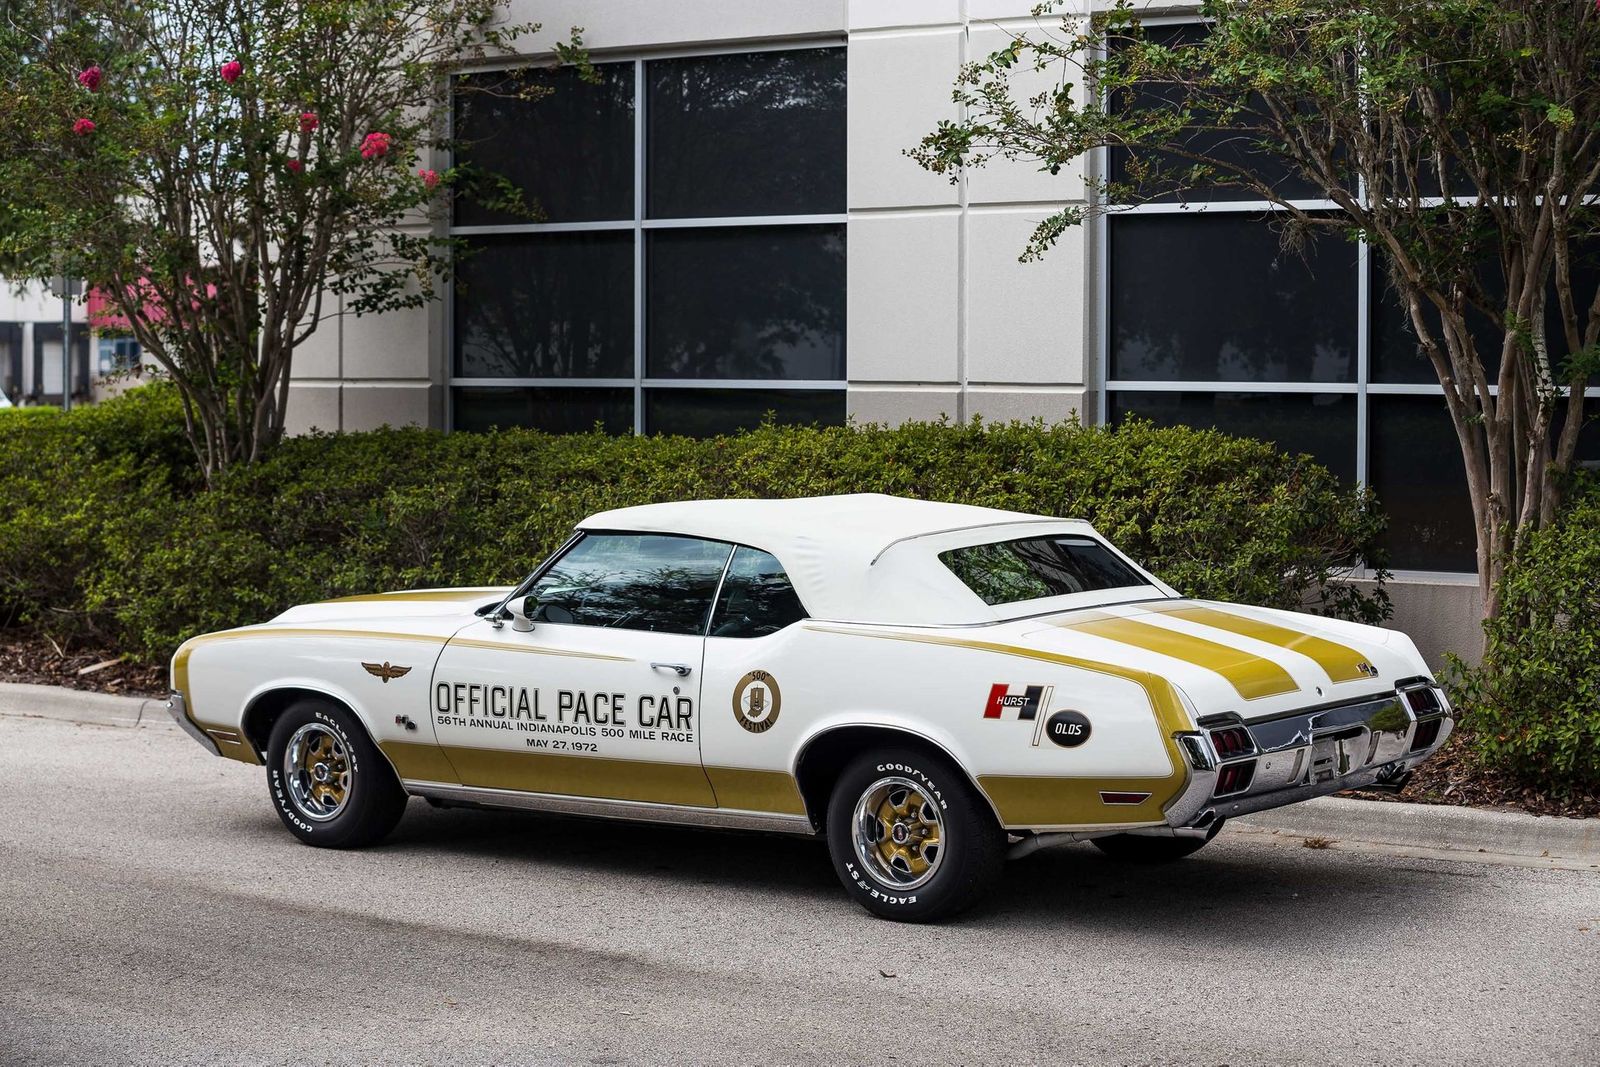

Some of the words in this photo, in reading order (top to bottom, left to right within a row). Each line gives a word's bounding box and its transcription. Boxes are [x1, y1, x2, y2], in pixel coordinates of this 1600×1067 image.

[436, 681, 548, 721] OFFICIAL
[557, 689, 626, 727] PACE
[638, 694, 693, 731] CAR
[996, 696, 1030, 707] HURST
[315, 711, 348, 740] EAGLE
[437, 716, 467, 726] 56TH
[469, 719, 514, 730] ANNUAL
[517, 722, 597, 736] INDIANAPOLIS
[601, 728, 625, 738] 500
[629, 730, 656, 740] MILE
[661, 732, 694, 743] RACE
[739, 716, 773, 732] FESTIVAL
[1055, 723, 1083, 735] OLDS
[526, 738, 549, 748] MAY
[876, 763, 948, 810] GOODYEAR
[272, 769, 313, 833] GOODYEAR
[870, 889, 917, 905] EAGLE
